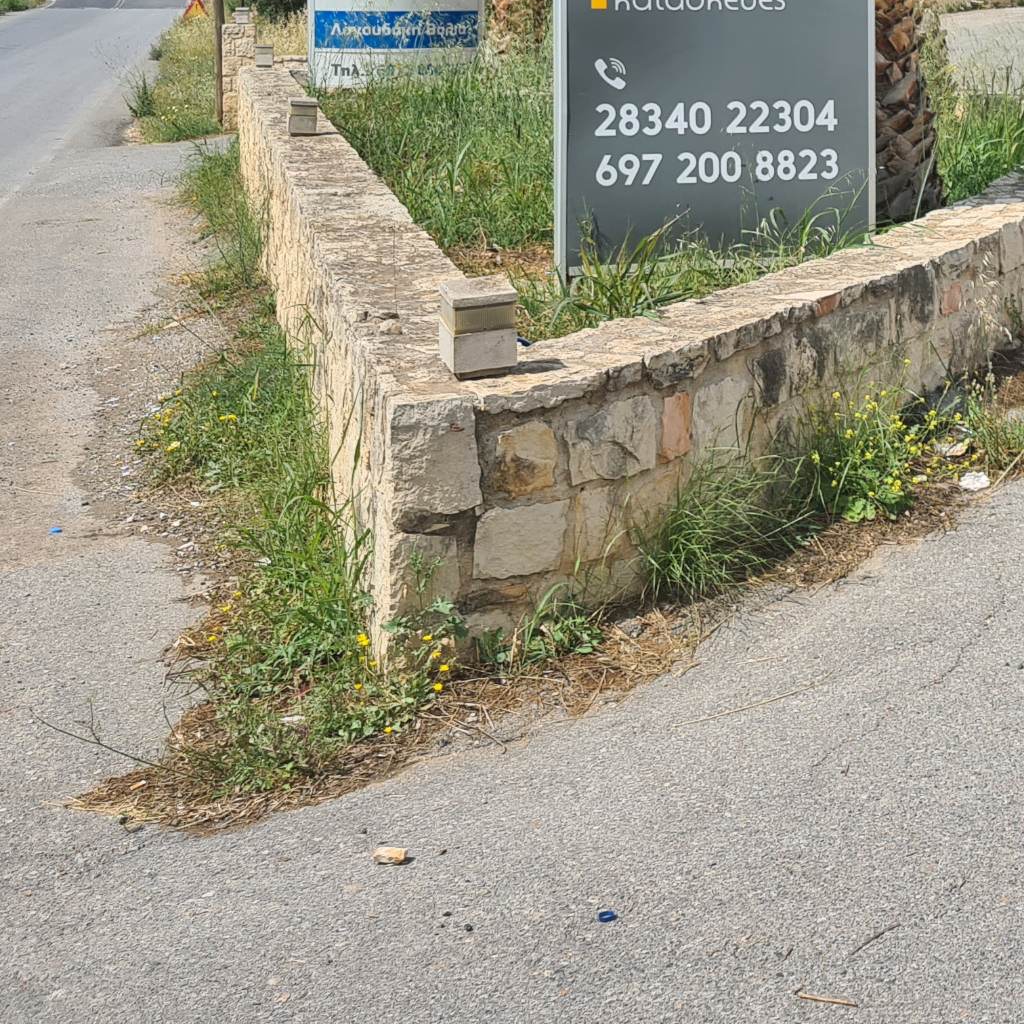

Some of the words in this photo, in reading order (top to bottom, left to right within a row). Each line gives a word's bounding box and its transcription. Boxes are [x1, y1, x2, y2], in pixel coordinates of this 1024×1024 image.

[594, 102, 712, 137] 28340
[726, 99, 839, 134] 22304
[595, 153, 663, 187] 697
[676, 150, 742, 184] 200
[755, 148, 840, 182] 8823
